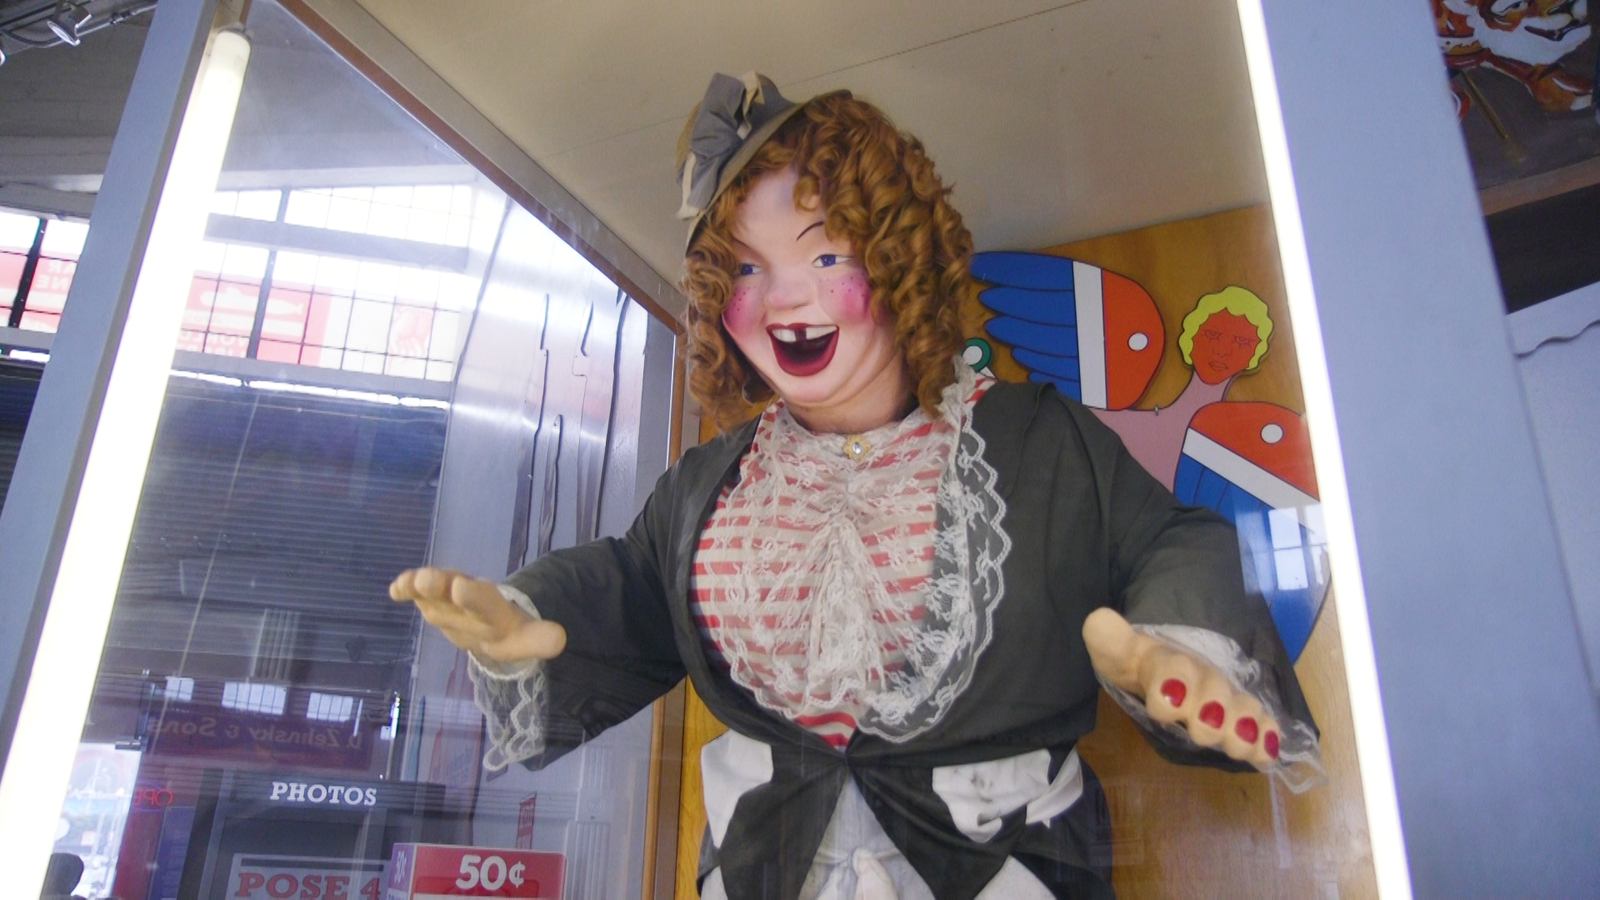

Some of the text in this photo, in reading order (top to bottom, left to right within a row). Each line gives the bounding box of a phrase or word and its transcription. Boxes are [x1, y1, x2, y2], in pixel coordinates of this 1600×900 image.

[269, 781, 377, 806] PHOTOS
[234, 872, 381, 900] POSE 4
[455, 854, 527, 891] 50¢
